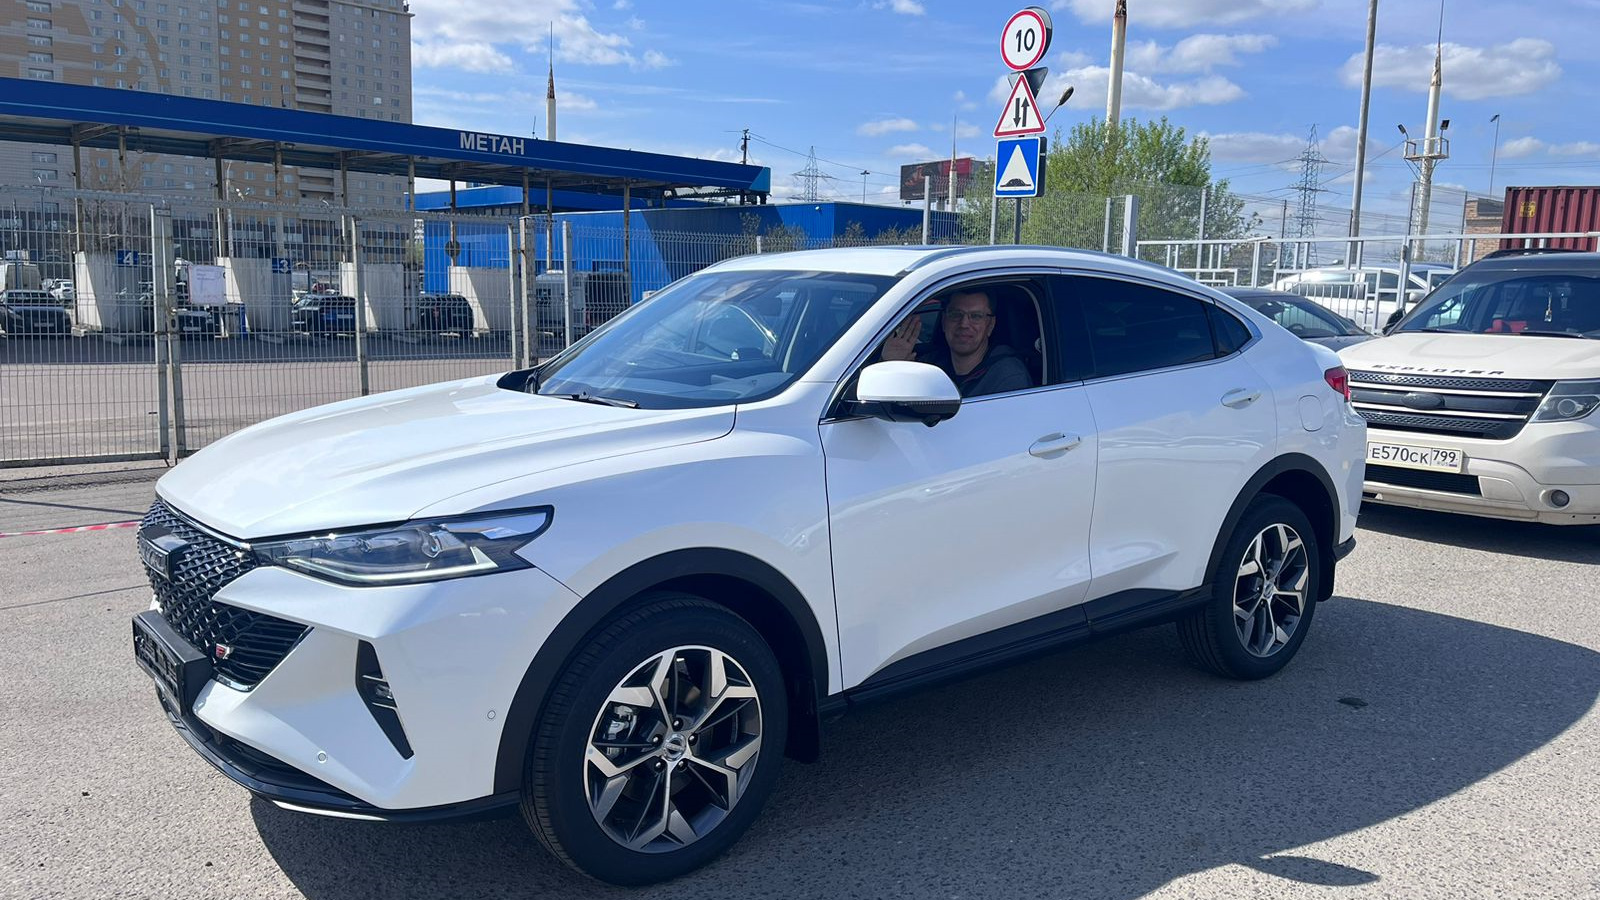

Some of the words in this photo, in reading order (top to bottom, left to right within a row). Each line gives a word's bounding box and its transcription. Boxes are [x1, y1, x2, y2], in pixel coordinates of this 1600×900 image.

[1016, 28, 1035, 52] 10
[460, 132, 525, 155] МЕТАН
[123, 252, 133, 265] 4
[280, 259, 288, 272] 3
[1371, 364, 1505, 375] EXPLORER
[1372, 446, 1429, 464] Е570СК
[1433, 449, 1456, 463] 799
